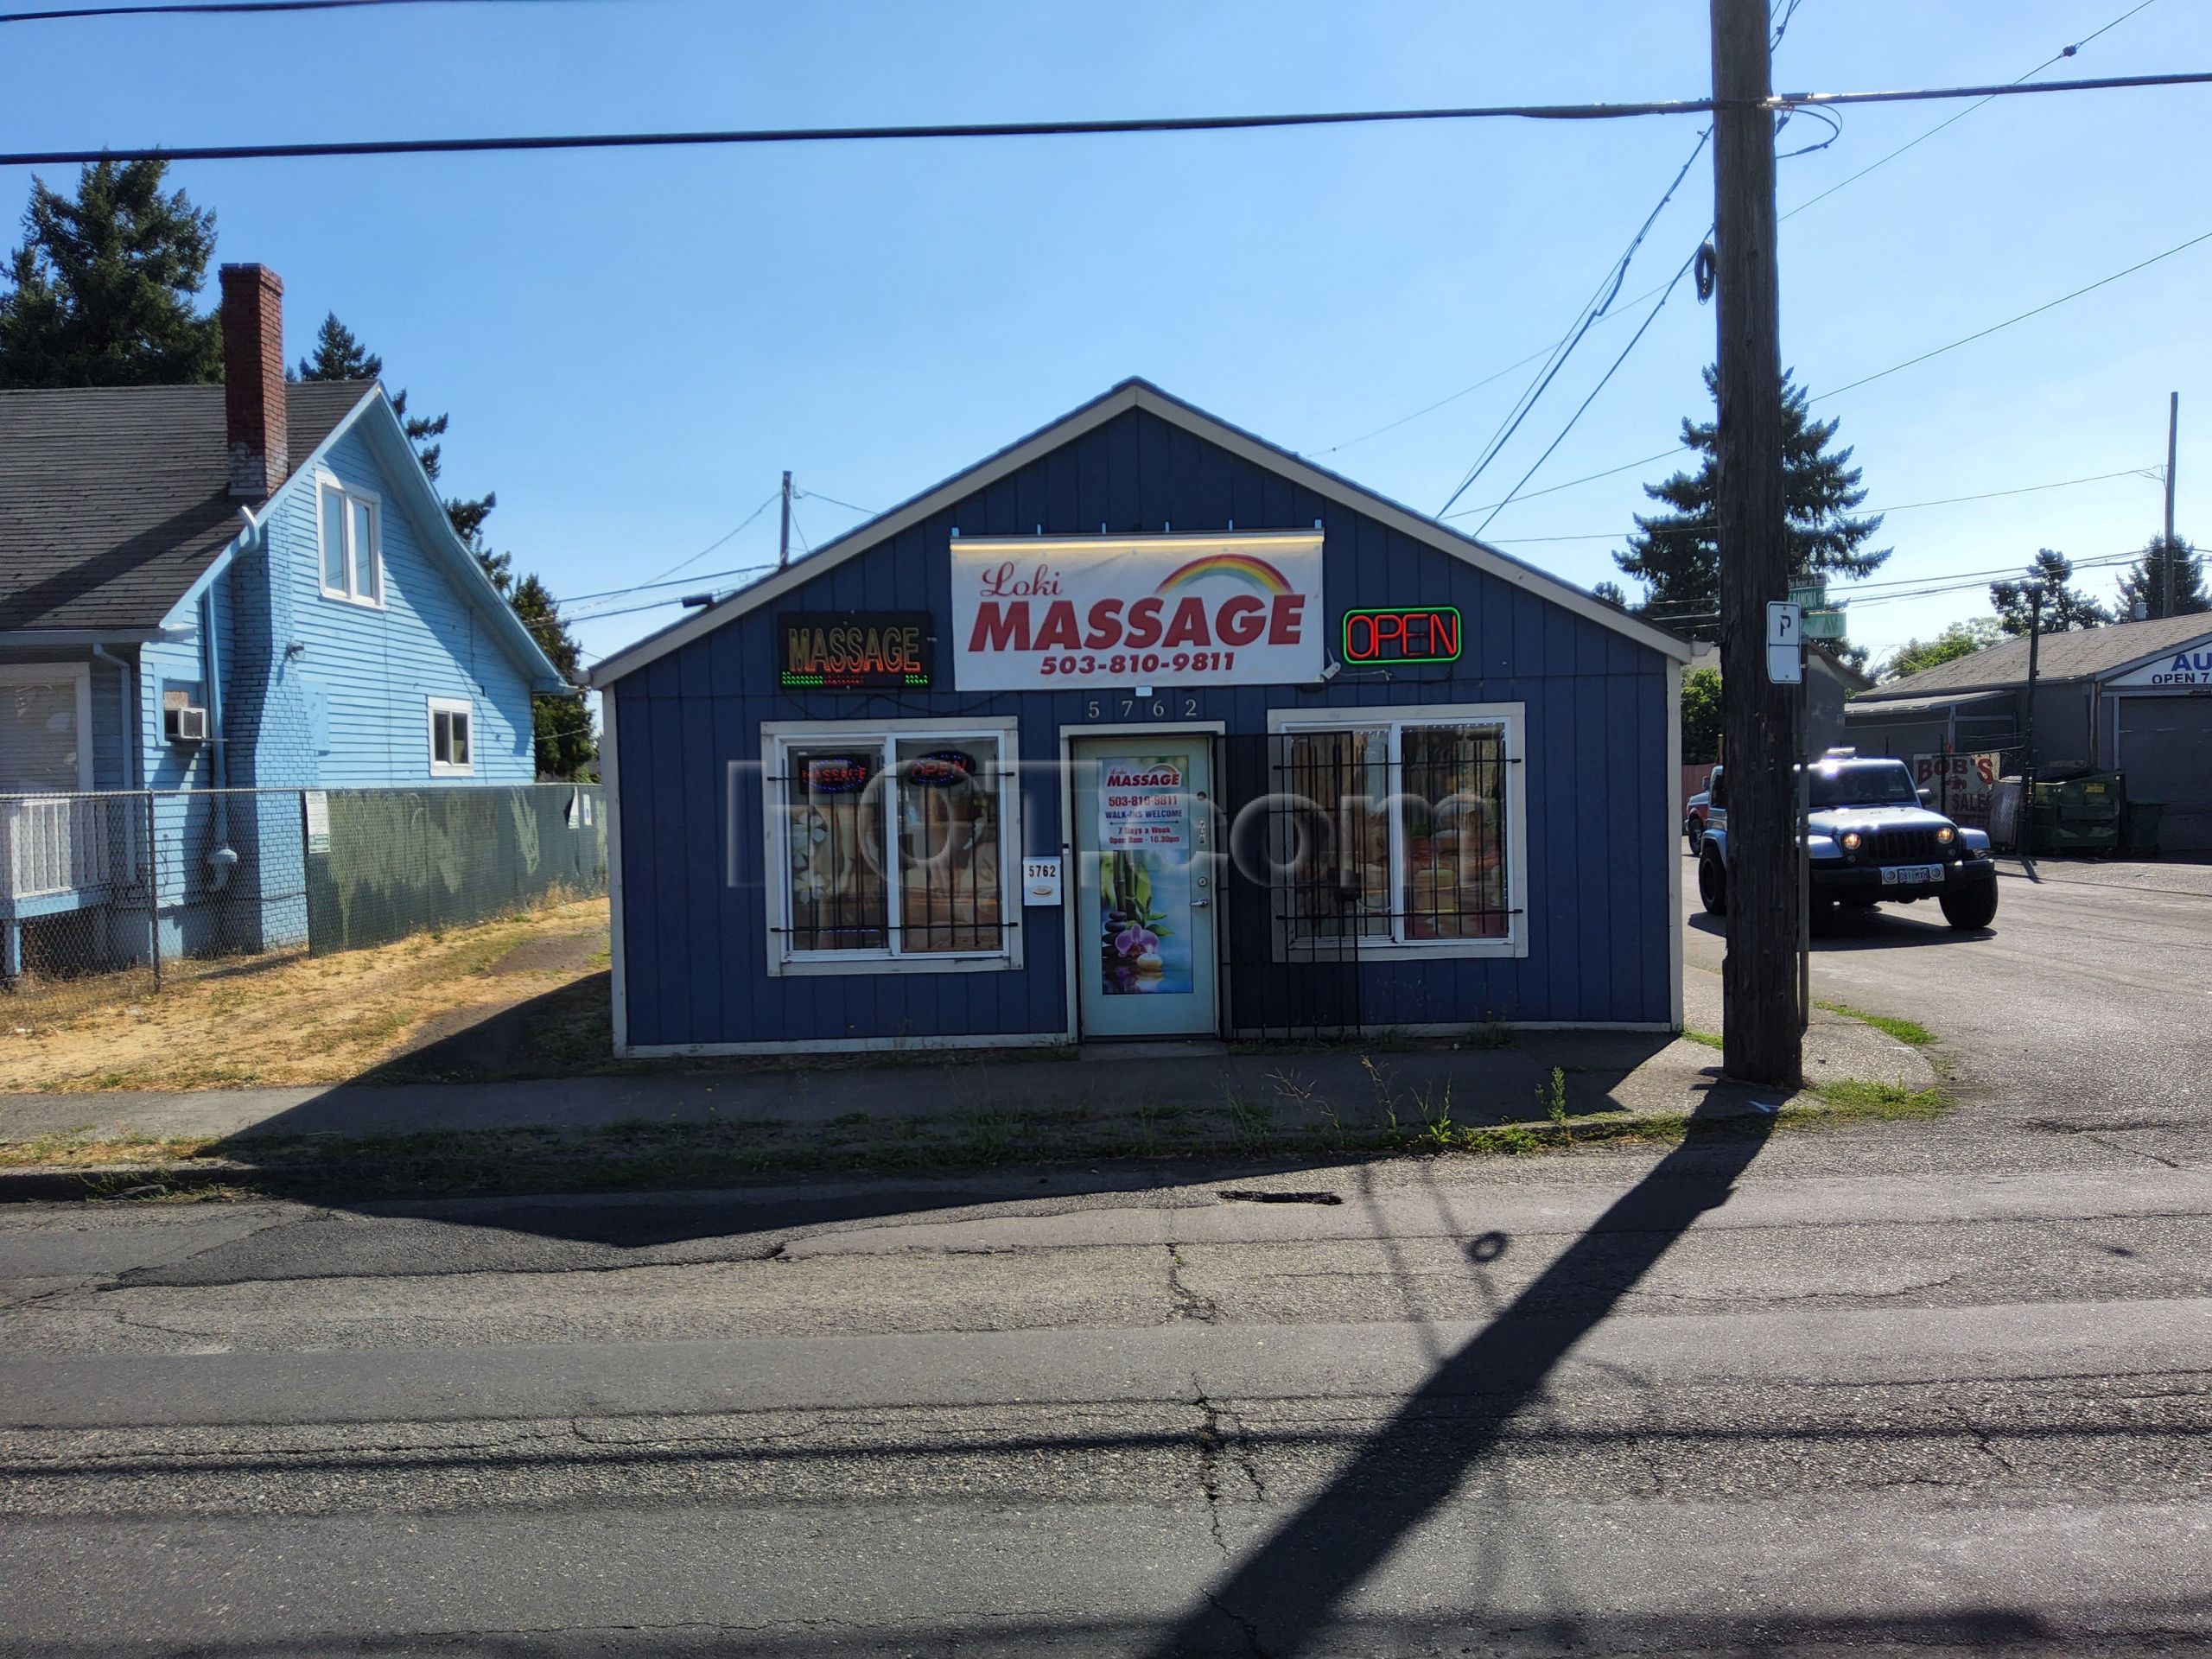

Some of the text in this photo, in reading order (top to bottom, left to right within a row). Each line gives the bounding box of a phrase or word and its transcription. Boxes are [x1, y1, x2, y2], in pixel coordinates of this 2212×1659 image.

[980, 561, 1064, 597] Loki
[967, 594, 1306, 652] MASSAGE
[1347, 613, 1458, 660] OPEN
[788, 626, 921, 673] MASSAGE
[1039, 652, 1235, 675] 503-810-9811
[2171, 652, 2212, 671] AU
[2152, 672, 2210, 684] OPEN 7
[802, 766, 868, 783] MASSAGE
[912, 758, 967, 777] OPEN
[1917, 758, 1994, 785] BOB'S
[1107, 774, 1179, 787] MASSAGE
[1109, 795, 1178, 807] 503-810-9811
[1145, 809, 1183, 818] WELCOME
[1124, 827, 1142, 836] Days
[1028, 865, 1056, 878] 5762
